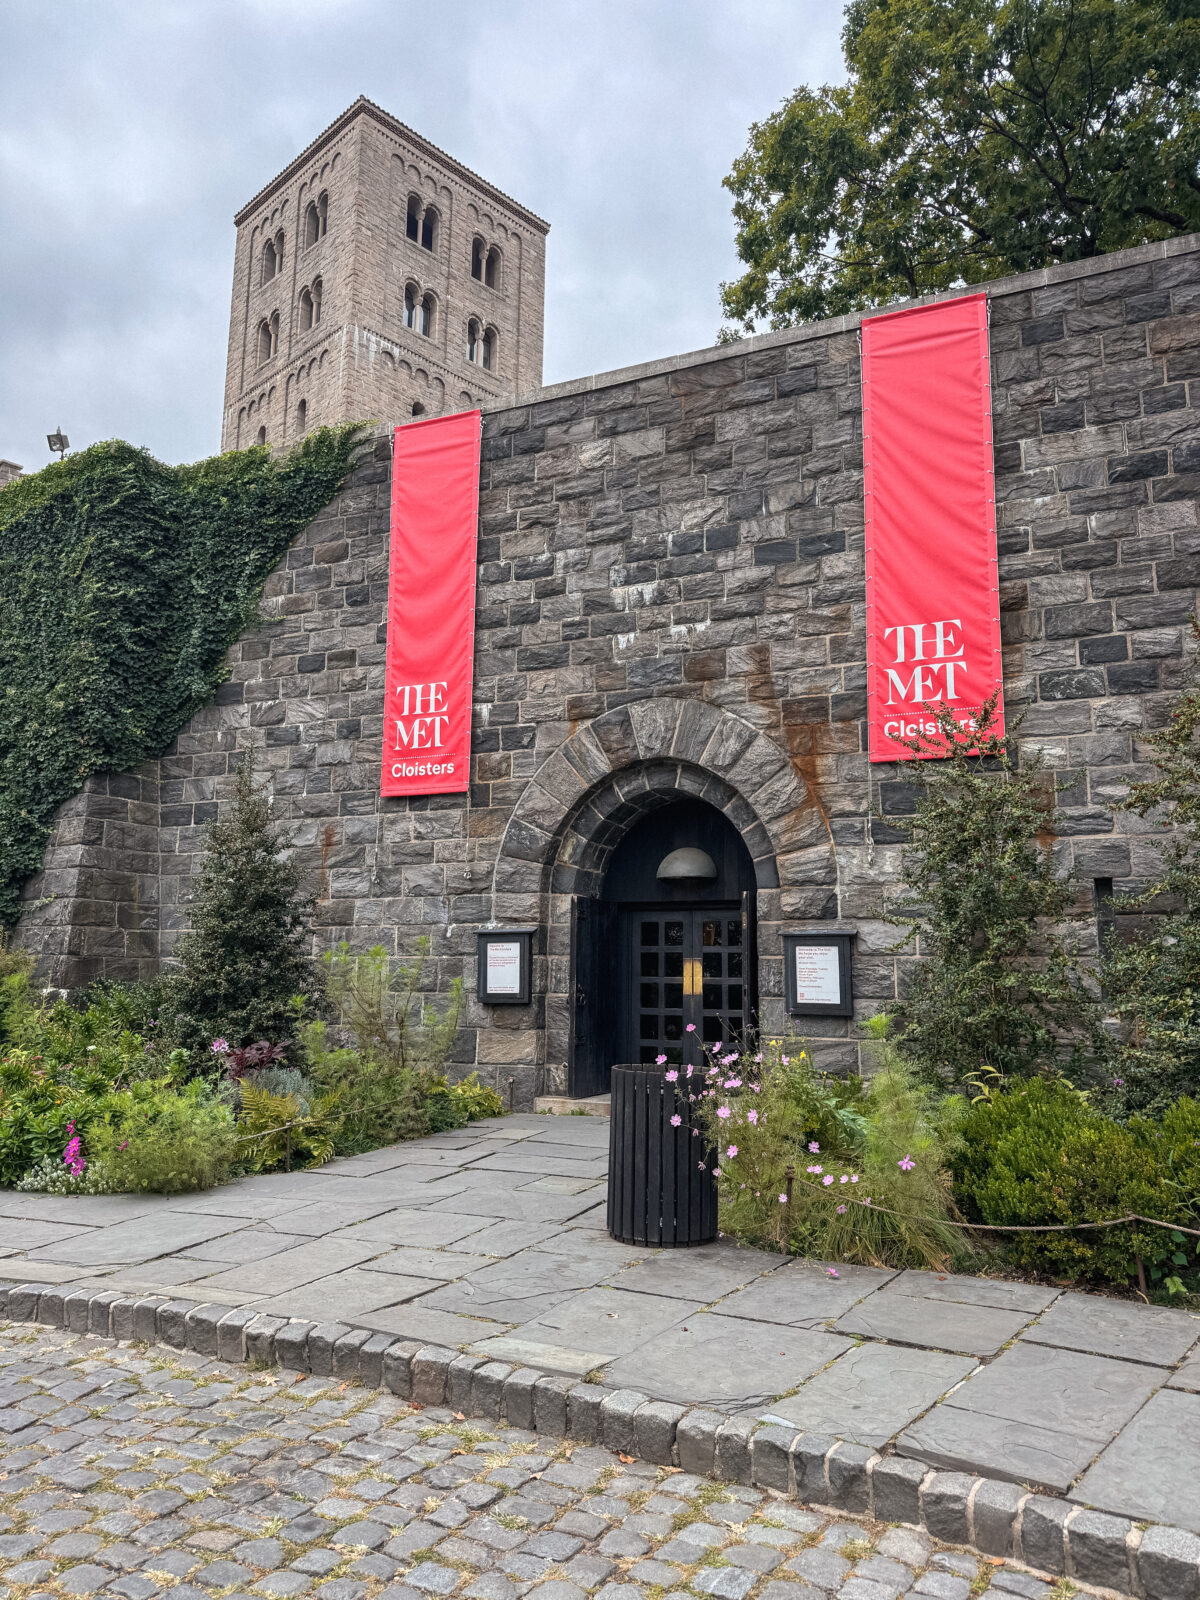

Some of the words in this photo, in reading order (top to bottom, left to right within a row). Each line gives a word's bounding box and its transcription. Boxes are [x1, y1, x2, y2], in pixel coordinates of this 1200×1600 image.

[884, 619, 964, 664] THE
[396, 682, 449, 716] THE
[883, 661, 967, 706] MET
[393, 716, 450, 751] MET
[391, 762, 455, 778] Cloisters
